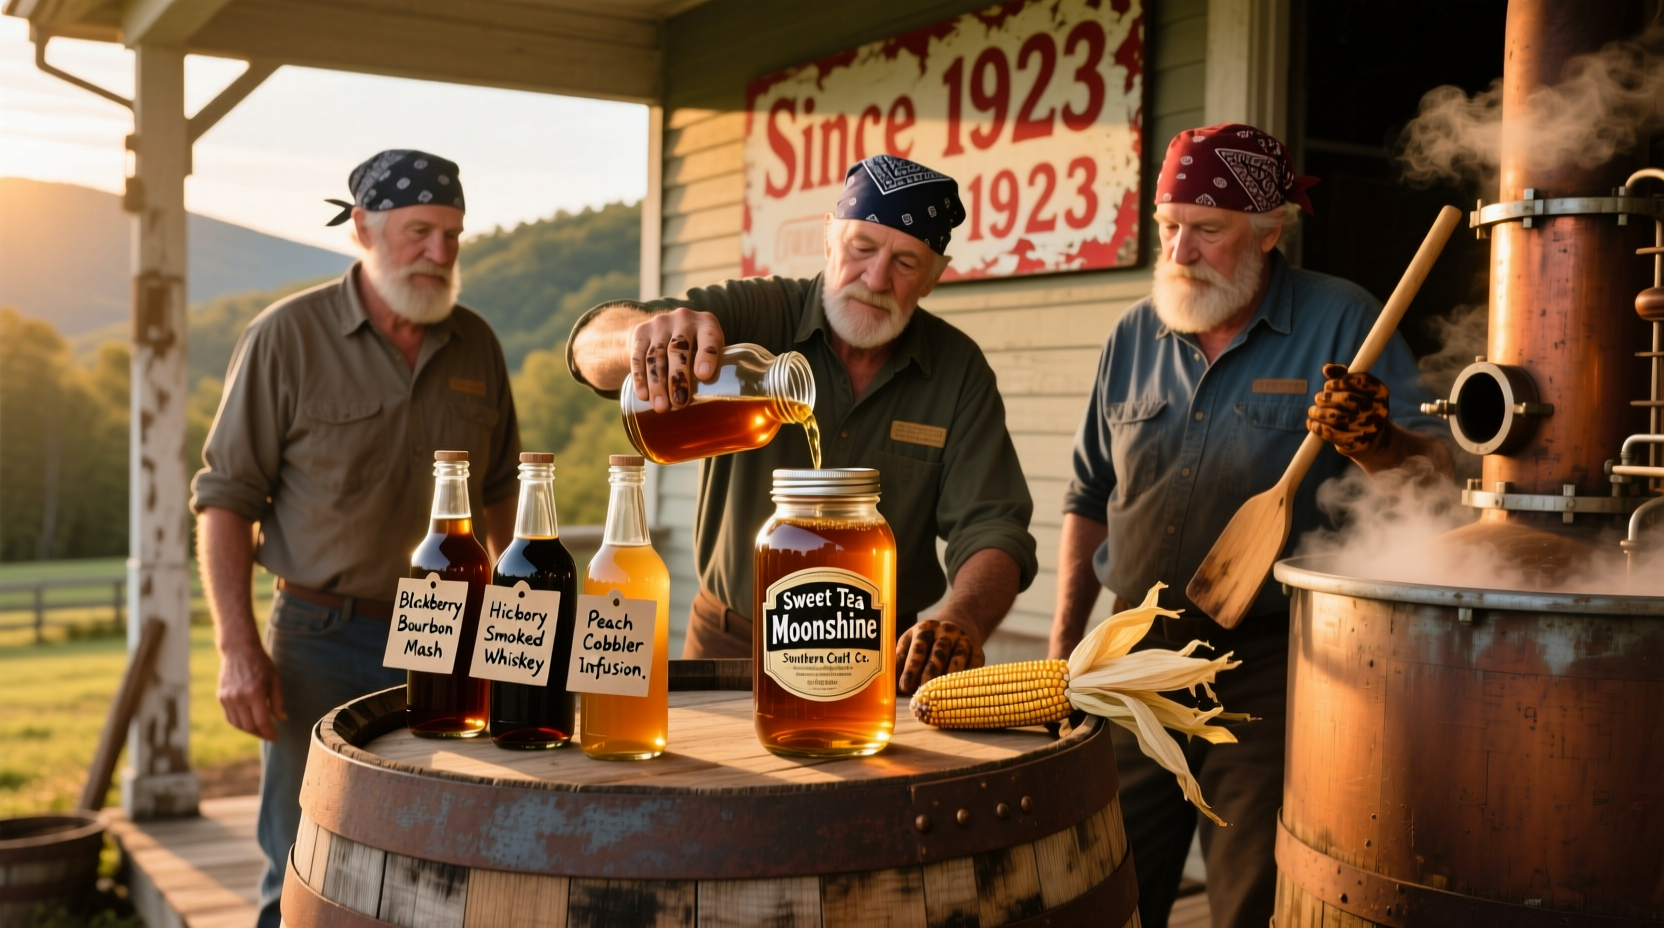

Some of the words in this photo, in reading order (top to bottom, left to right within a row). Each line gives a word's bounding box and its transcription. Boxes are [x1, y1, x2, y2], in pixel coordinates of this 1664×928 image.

[765, 94, 915, 200] Since
[942, 20, 1106, 157] 1923
[967, 156, 1099, 242] 1923
[783, 589, 832, 610] Sweet
[836, 587, 864, 610] Tea
[397, 614, 453, 636] Bourbon
[587, 609, 633, 631] Peach
[772, 611, 877, 645] Moonshine
[484, 625, 545, 647] Smoked
[583, 633, 644, 653] Cobbler
[404, 639, 443, 659] Mash
[484, 648, 545, 678] Whiskey
[579, 656, 646, 680] Infusion.
